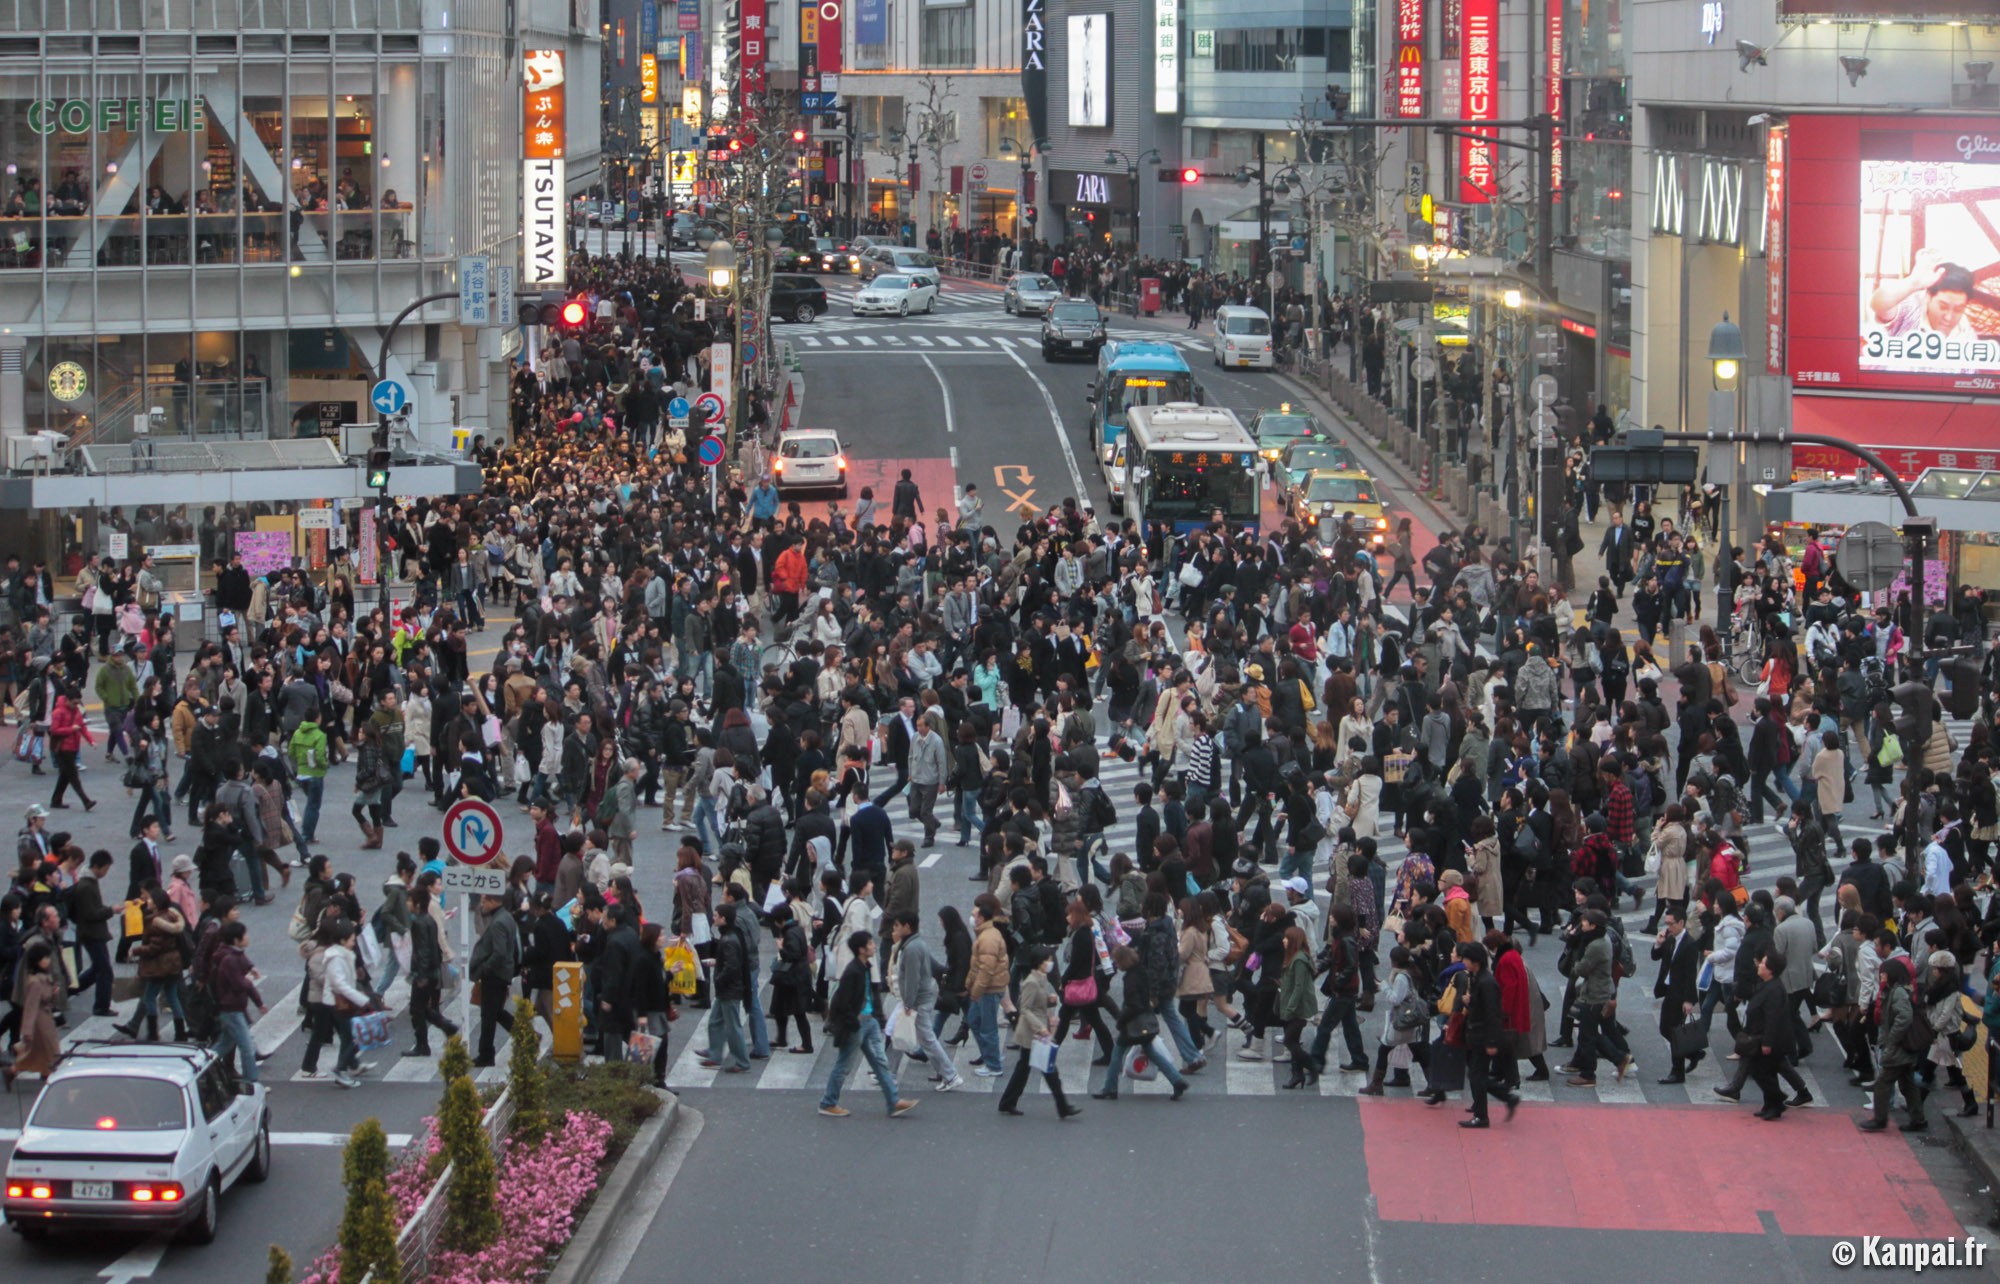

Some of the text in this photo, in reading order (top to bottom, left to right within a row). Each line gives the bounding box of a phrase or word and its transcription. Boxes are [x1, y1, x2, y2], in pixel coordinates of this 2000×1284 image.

[1410, 0, 1421, 38] ドナルド
[1403, 78, 1417, 87] 2F
[27, 98, 206, 135] COFFEE
[1076, 173, 1109, 204] ZARA
[535, 160, 555, 283] TSUTAYA
[472, 261, 485, 320] 渋谷駅前
[1867, 331, 1996, 363] 3月29日(月)
[1797, 371, 1841, 382] 三千里薬品
[1172, 453, 1233, 464] 渋谷駅
[1804, 452, 1841, 467] クスリ
[446, 873, 501, 889] ここから
